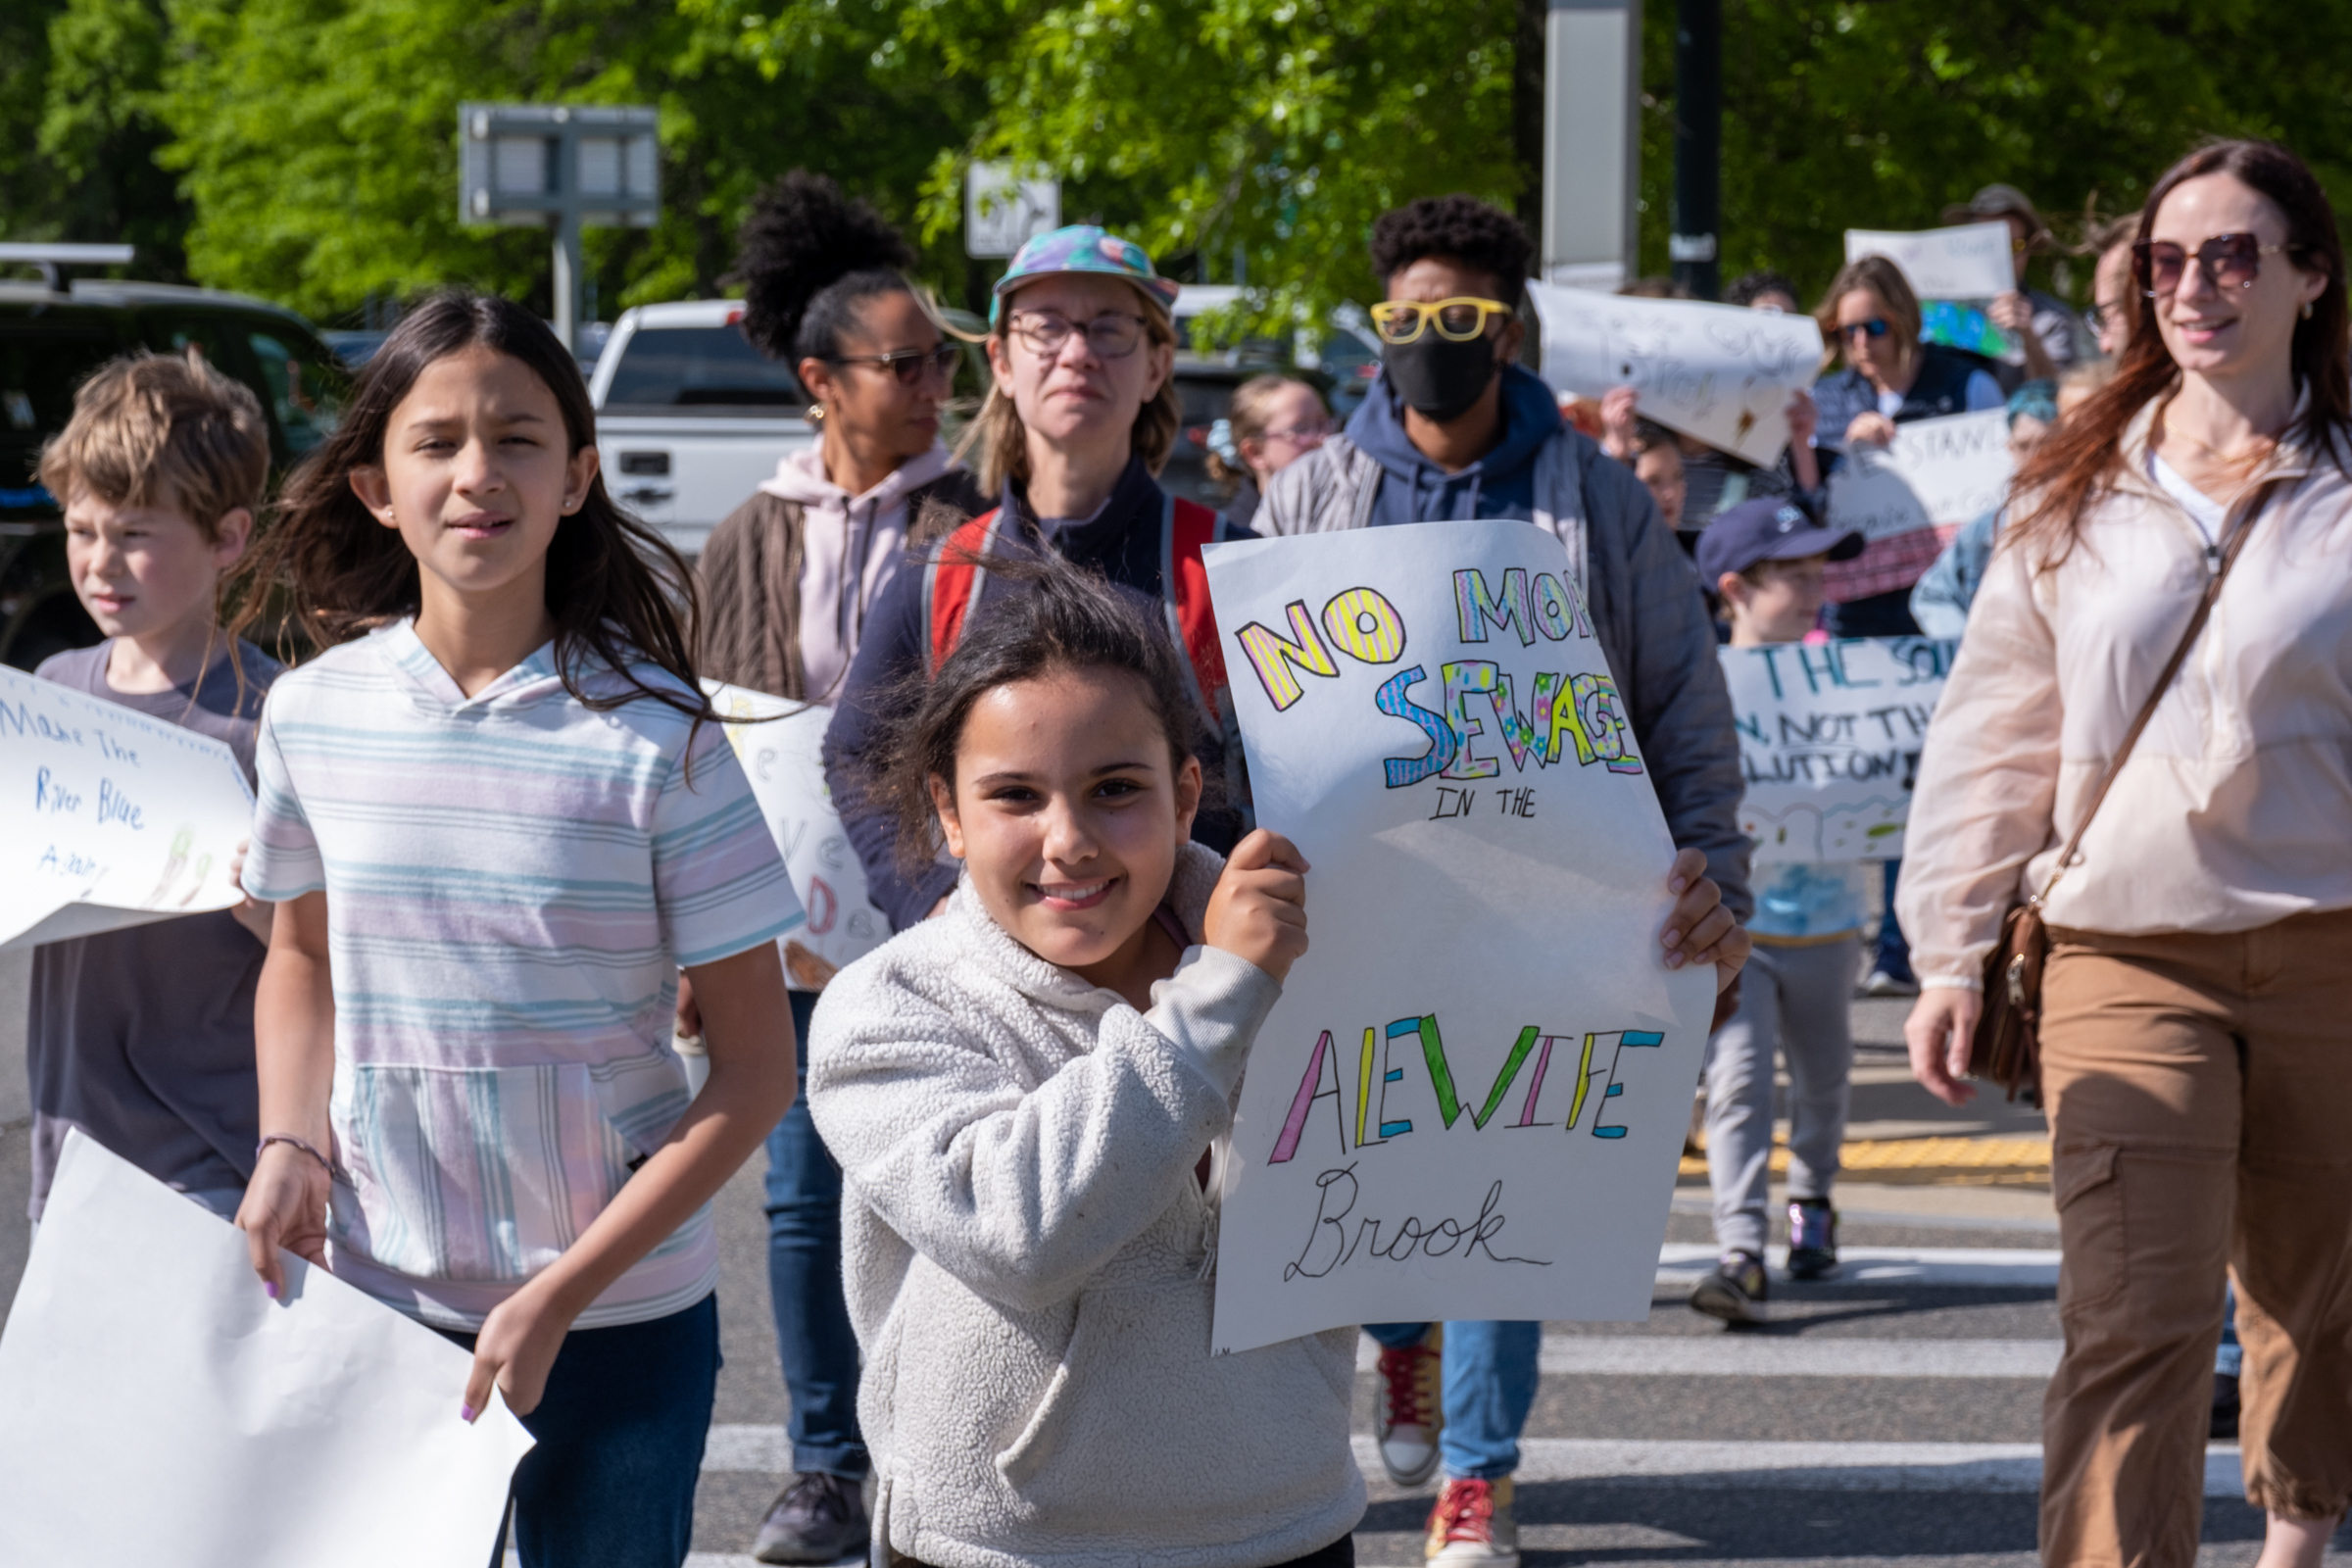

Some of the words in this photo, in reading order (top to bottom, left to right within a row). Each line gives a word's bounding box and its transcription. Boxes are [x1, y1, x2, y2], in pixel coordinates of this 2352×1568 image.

[1235, 586, 1407, 711] NO
[1749, 637, 1882, 702] THE
[93, 728, 141, 768] The
[1375, 660, 1643, 788] SEWAGE
[1778, 711, 1860, 745] NOT
[1866, 704, 1935, 741] TH
[35, 764, 83, 813] River
[97, 777, 145, 831] Blue
[1745, 748, 1920, 790] LUTION!
[1429, 787, 1476, 820] IN
[1495, 787, 1537, 818] THE
[1267, 1012, 1666, 1166] ALEWIFE
[1284, 1160, 1553, 1283] Brook
